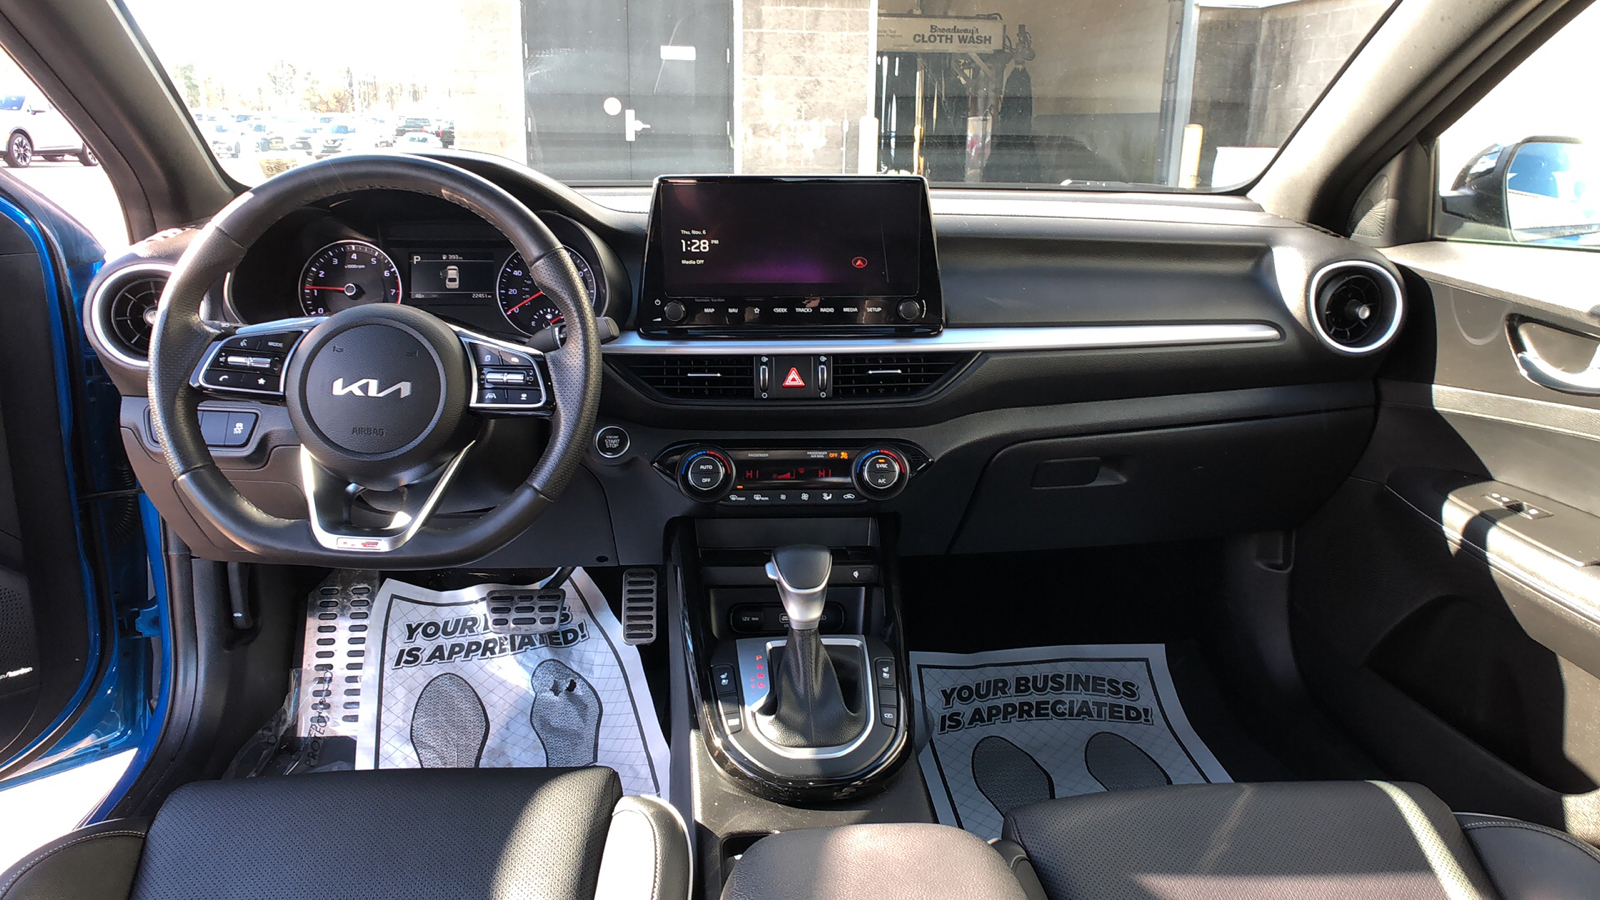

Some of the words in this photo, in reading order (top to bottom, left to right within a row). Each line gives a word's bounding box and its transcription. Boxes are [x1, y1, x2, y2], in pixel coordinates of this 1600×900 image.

[929, 25, 979, 36] Broadway's
[912, 33, 954, 43] CLOTH
[957, 35, 993, 44] WASH
[680, 239, 710, 252] 1:28
[370, 257, 377, 265] 5
[413, 255, 422, 265] P
[318, 270, 325, 278] 2
[313, 289, 318, 297] 1
[389, 288, 396, 296] 7
[317, 307, 324, 315] 0
[331, 377, 411, 399] KIA
[351, 426, 386, 437] AIRBAG
[404, 616, 481, 642] YOUR
[393, 647, 427, 668] IS
[427, 620, 588, 663] APPREIATED!
[940, 678, 1010, 707] YOUR
[1013, 673, 1140, 699] BUSINESS
[938, 712, 965, 734] IS
[967, 699, 1152, 725] APPRECIATED!
